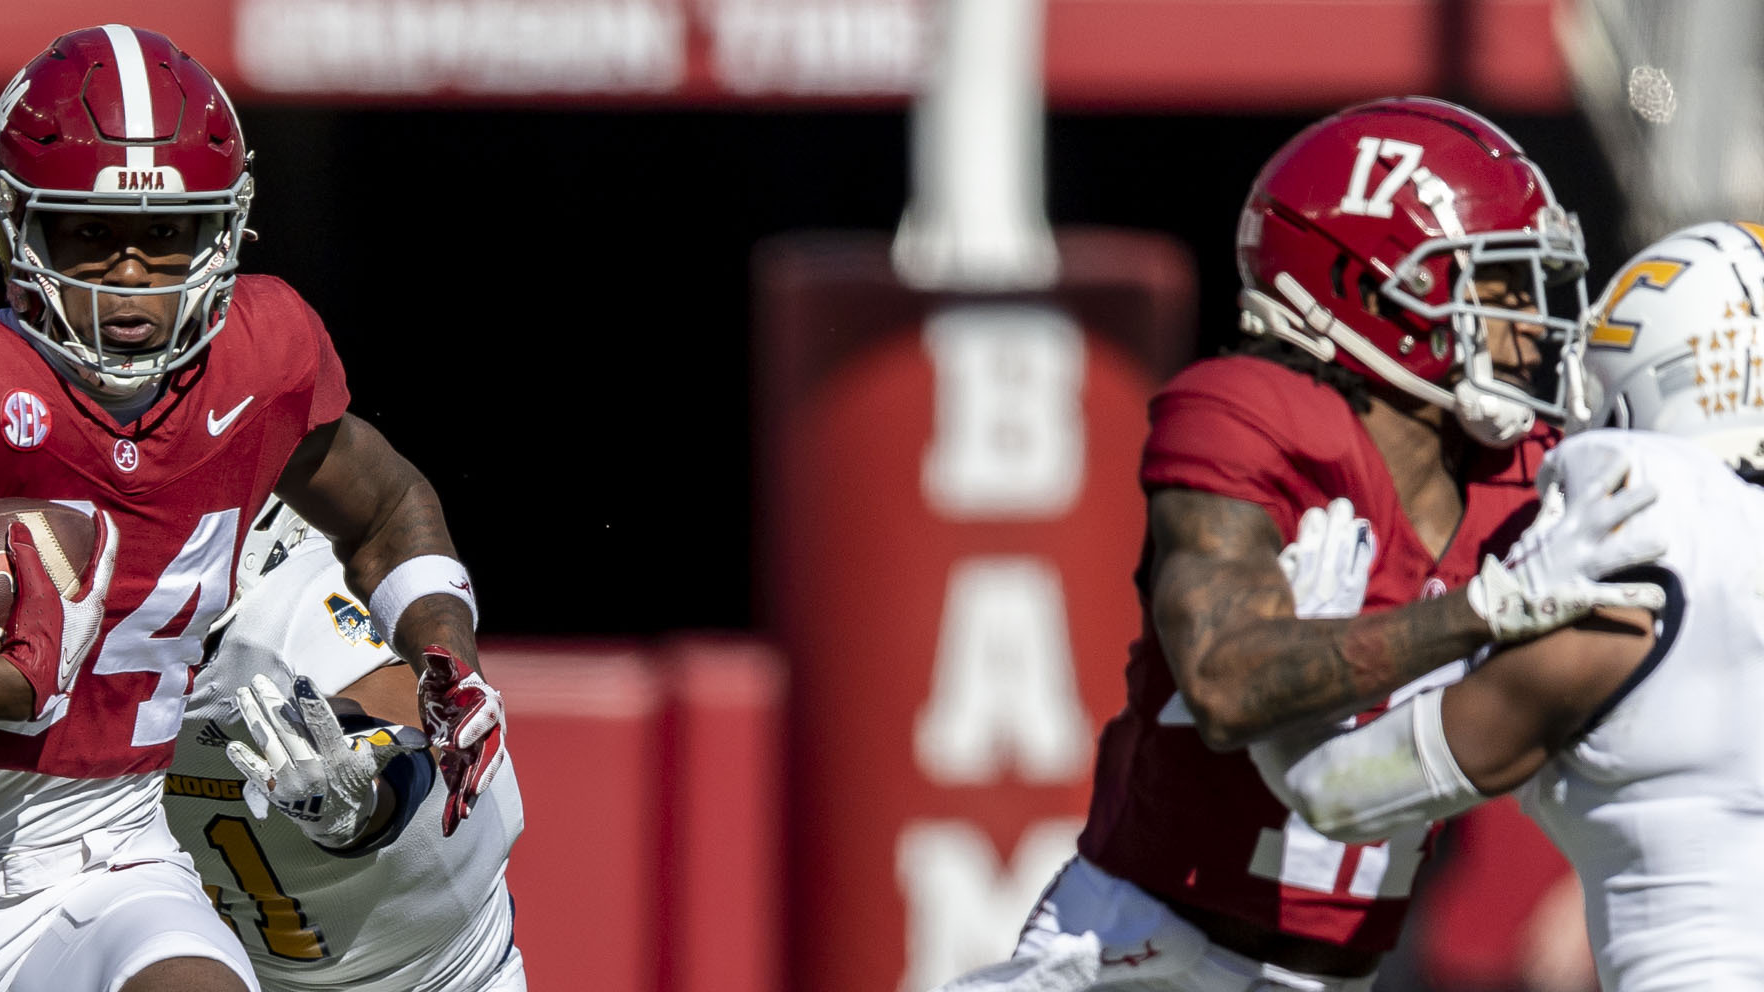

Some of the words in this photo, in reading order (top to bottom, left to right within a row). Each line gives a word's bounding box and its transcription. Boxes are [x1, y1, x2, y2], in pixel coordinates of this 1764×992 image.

[117, 170, 166, 191] BAMA
[1339, 136, 1424, 219] 17
[4, 390, 48, 448] SEC
[21, 500, 240, 747] 4
[164, 775, 242, 800] NOOG
[202, 813, 330, 961] 1
